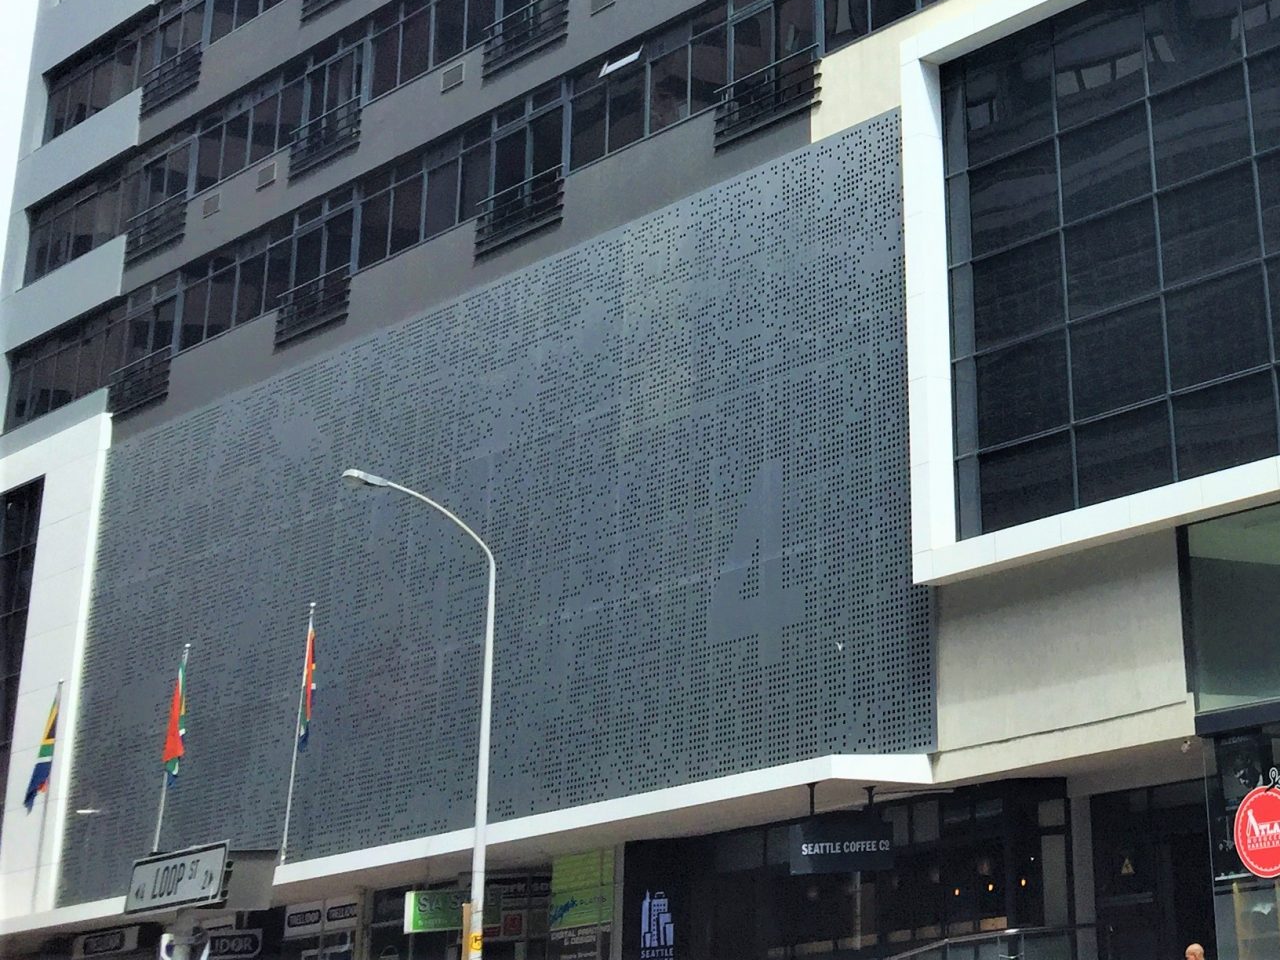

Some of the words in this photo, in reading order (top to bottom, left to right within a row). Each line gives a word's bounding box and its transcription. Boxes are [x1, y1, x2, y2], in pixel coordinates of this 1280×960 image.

[801, 842, 841, 855] SEATTLE
[843, 840, 877, 853] COFFEE
[151, 862, 186, 899] LOOP
[188, 859, 201, 880] ST
[641, 948, 674, 959] SEATTLE
